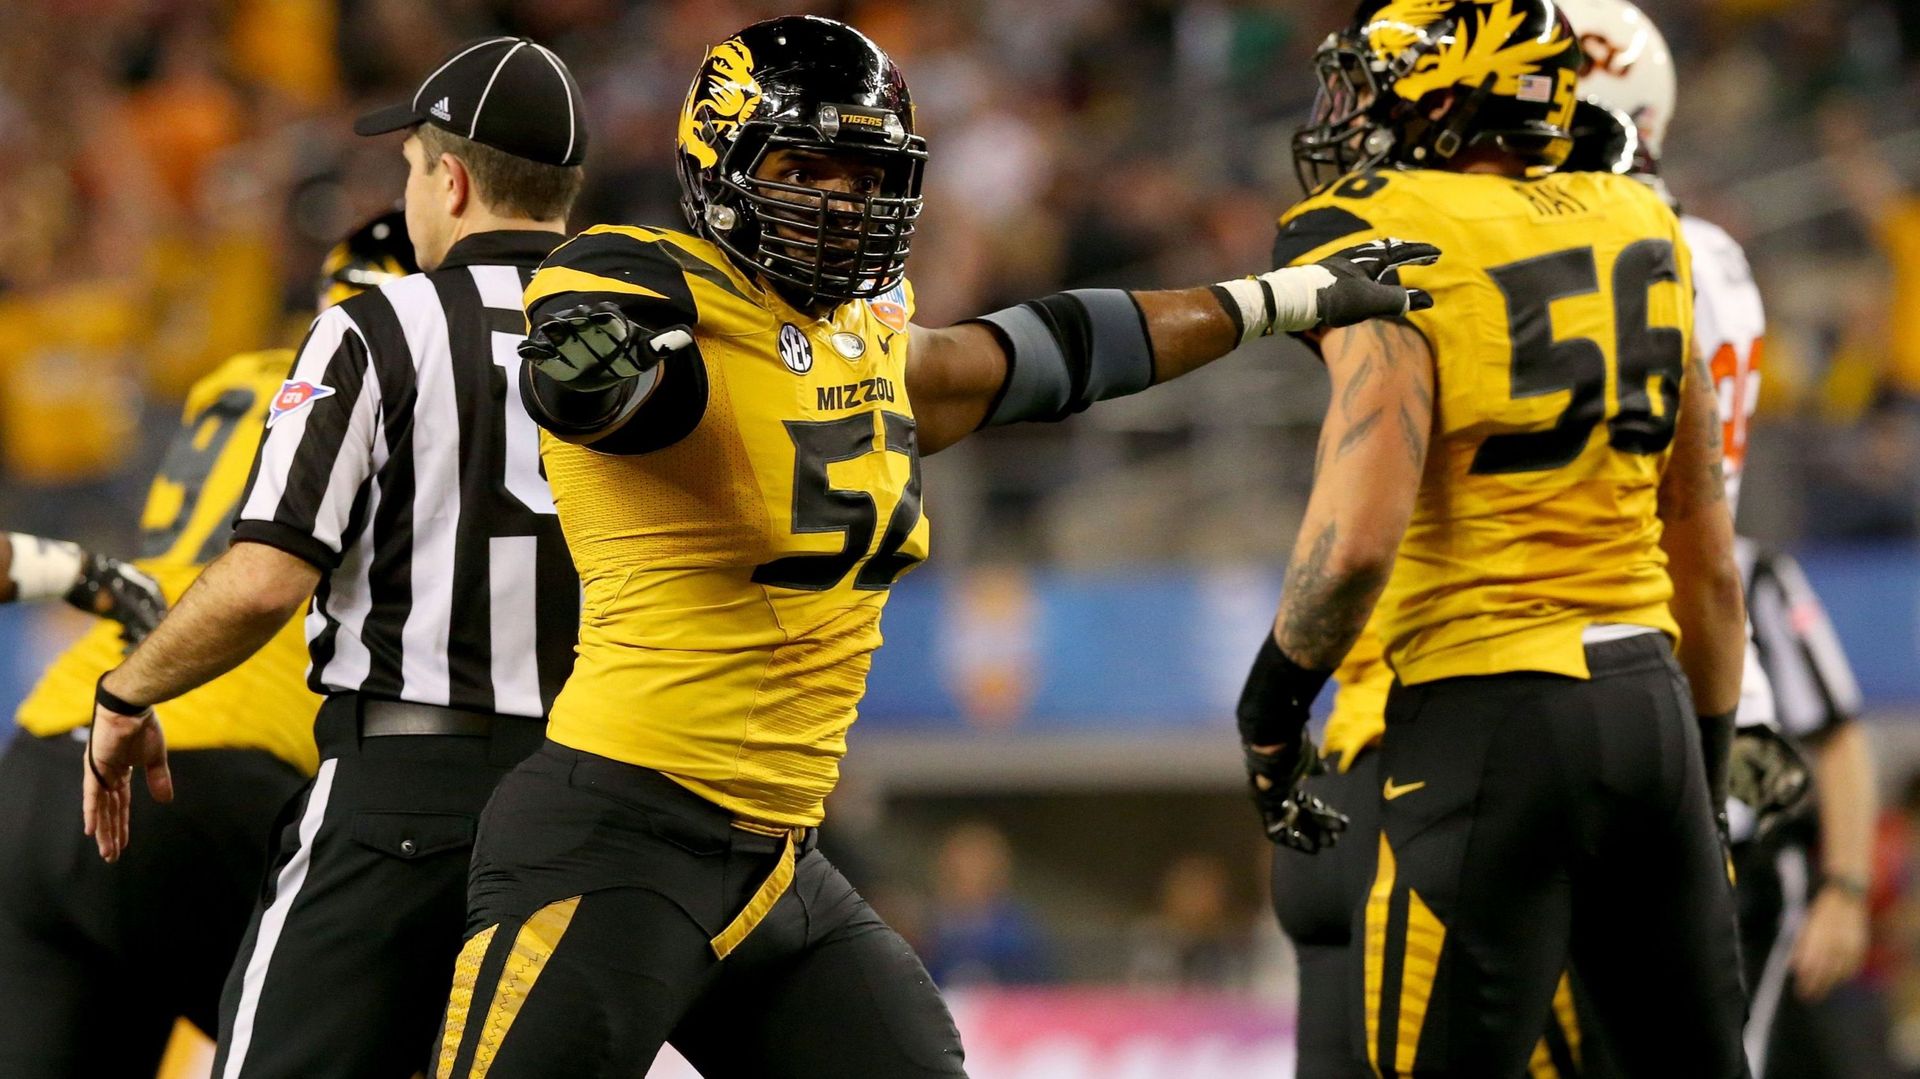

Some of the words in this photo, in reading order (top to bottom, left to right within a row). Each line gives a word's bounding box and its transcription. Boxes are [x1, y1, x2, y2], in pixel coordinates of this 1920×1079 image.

[841, 114, 882, 127] TIGERS
[1512, 185, 1588, 216] RAY
[780, 324, 813, 372] SEC
[1467, 238, 1684, 475] 56
[816, 377, 895, 411] MIZZOU
[751, 410, 924, 592] 52
